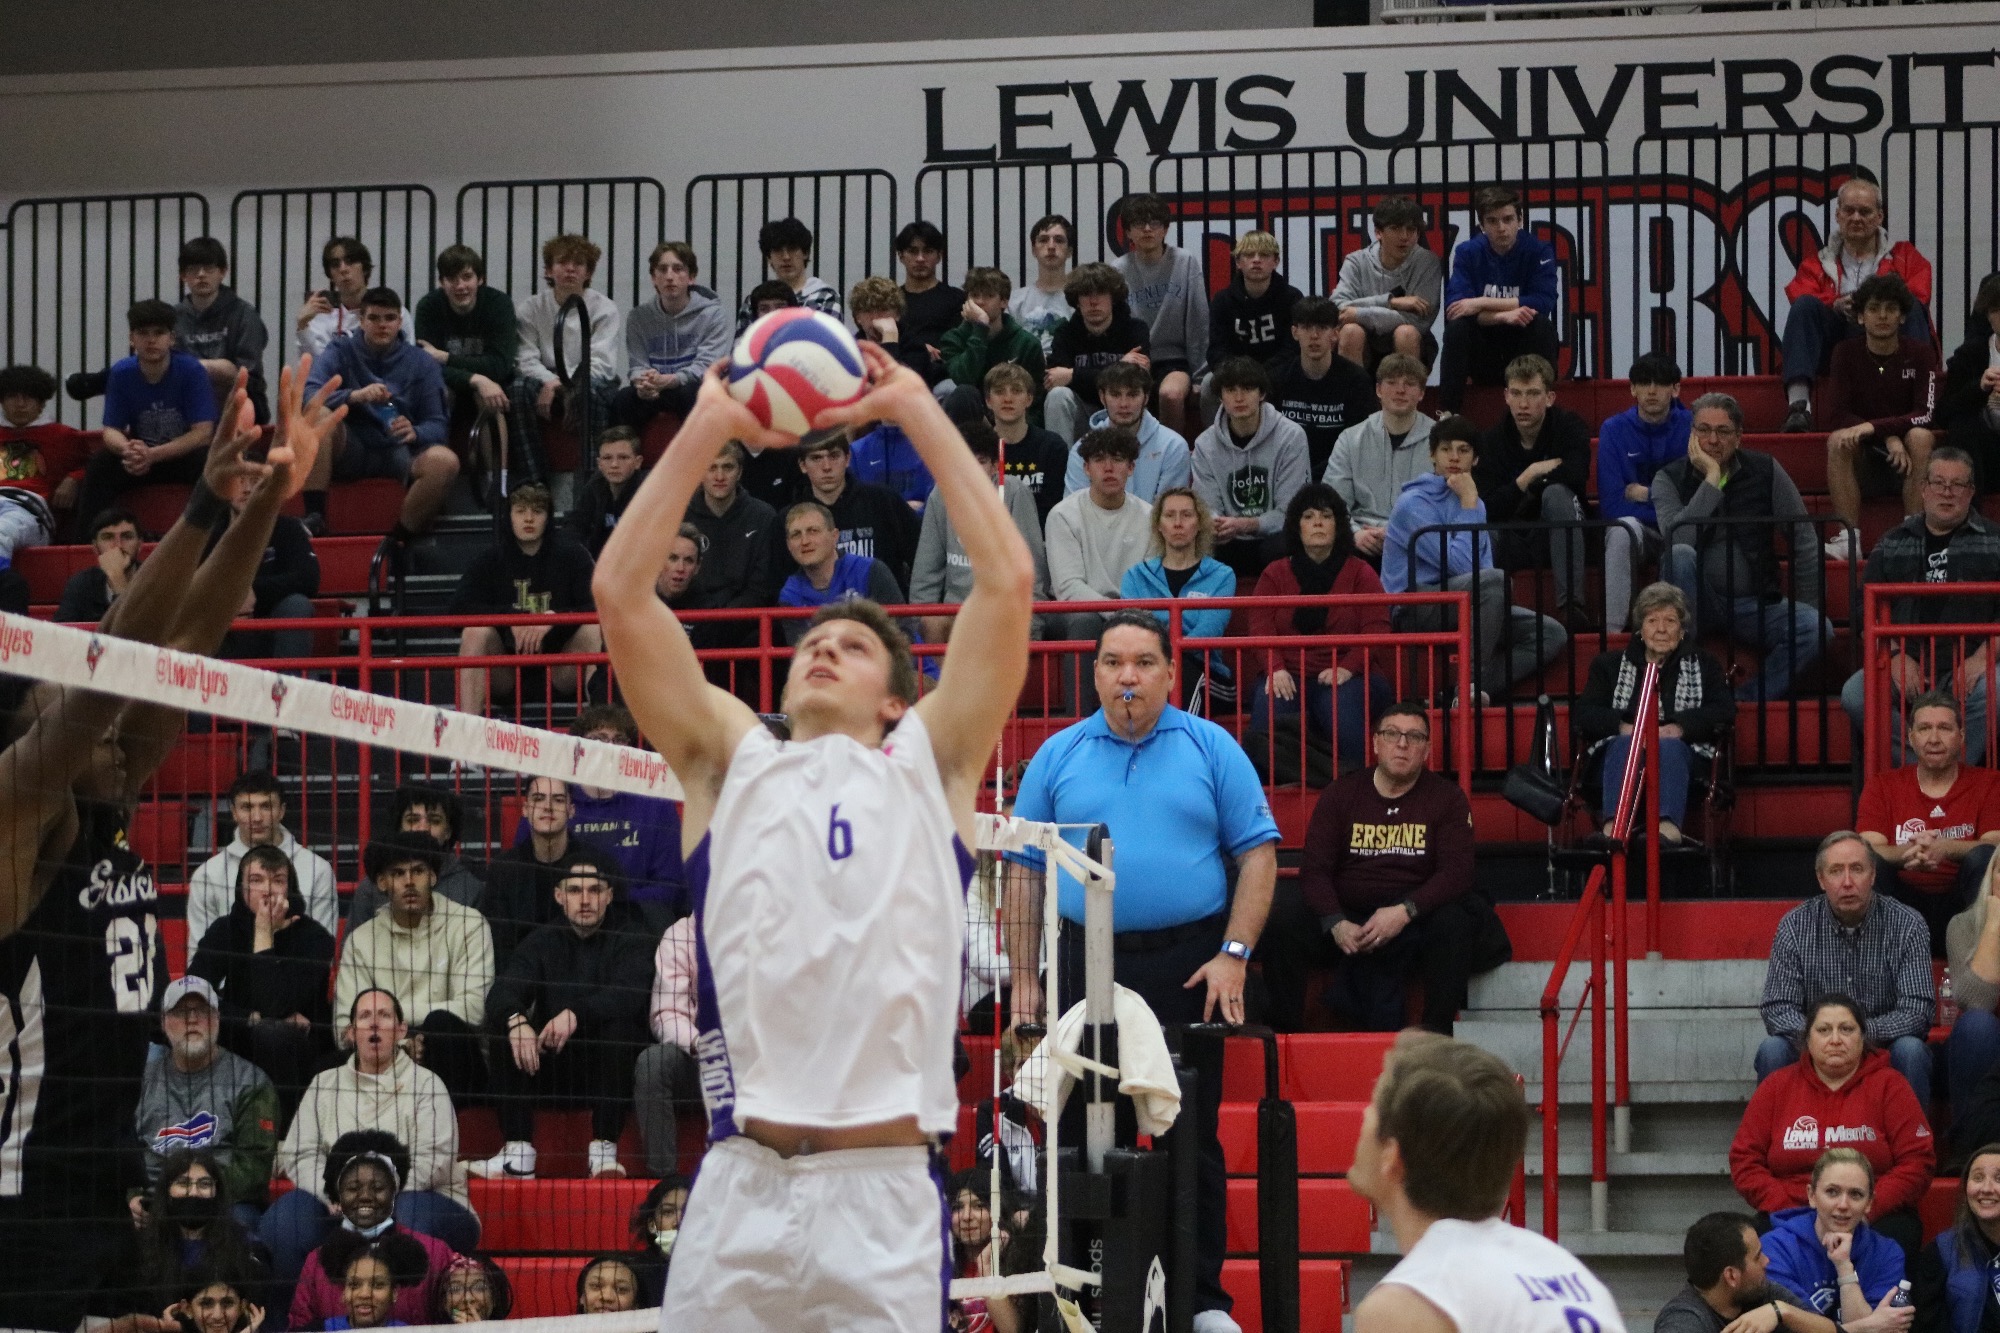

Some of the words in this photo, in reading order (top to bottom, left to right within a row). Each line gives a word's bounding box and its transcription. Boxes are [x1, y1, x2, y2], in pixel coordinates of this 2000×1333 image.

[922, 74, 1297, 163] LEWIS
[1343, 48, 2000, 150] UNIVERSIT
[1281, 410, 1345, 423] VOLLEYBALL
[828, 803, 853, 861] 6
[1350, 822, 1427, 849] ERSKINE
[1825, 1124, 1876, 1143] Men's
[1088, 1238, 1103, 1298] spos
[1514, 1271, 1593, 1302] LEWIS
